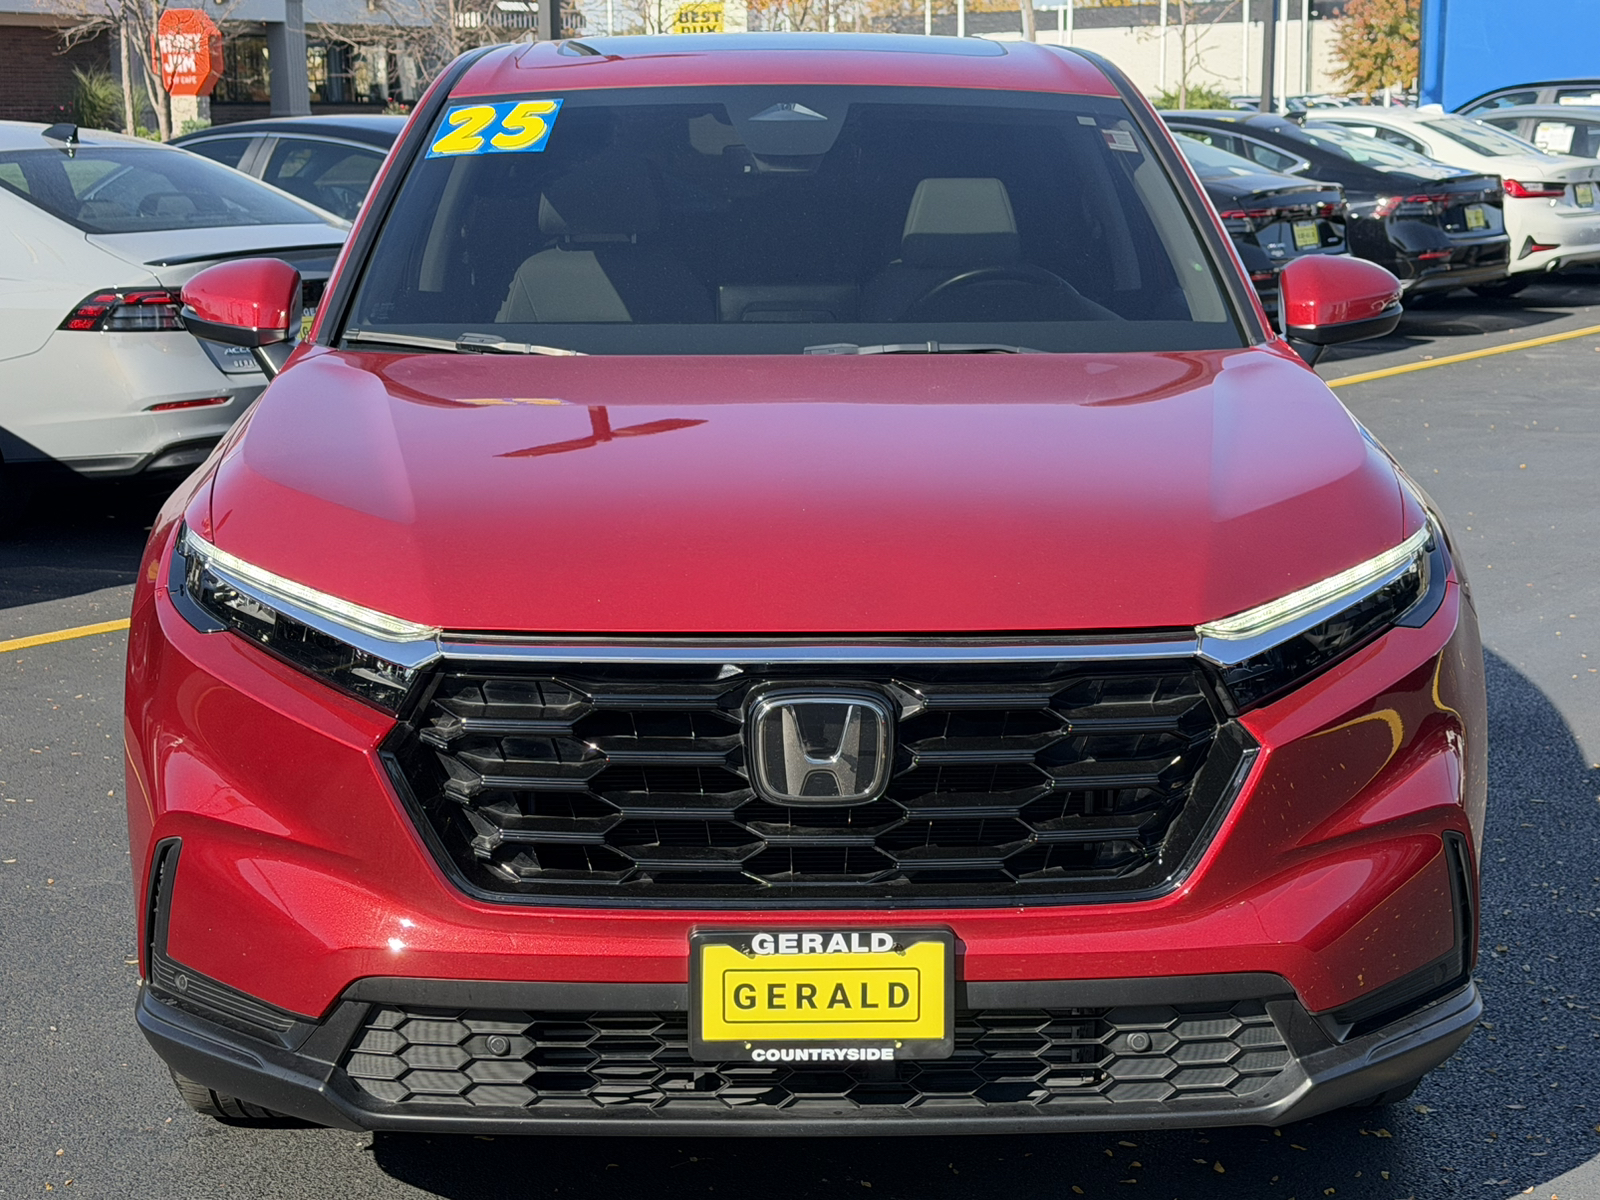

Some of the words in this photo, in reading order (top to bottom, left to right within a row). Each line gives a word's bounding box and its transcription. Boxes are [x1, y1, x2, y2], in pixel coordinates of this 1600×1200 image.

[679, 11, 722, 23] BEST
[432, 101, 557, 154] 25
[752, 932, 894, 955] GERALD
[733, 982, 910, 1010] GERALD
[752, 1048, 895, 1061] COUNTRYSIDE
